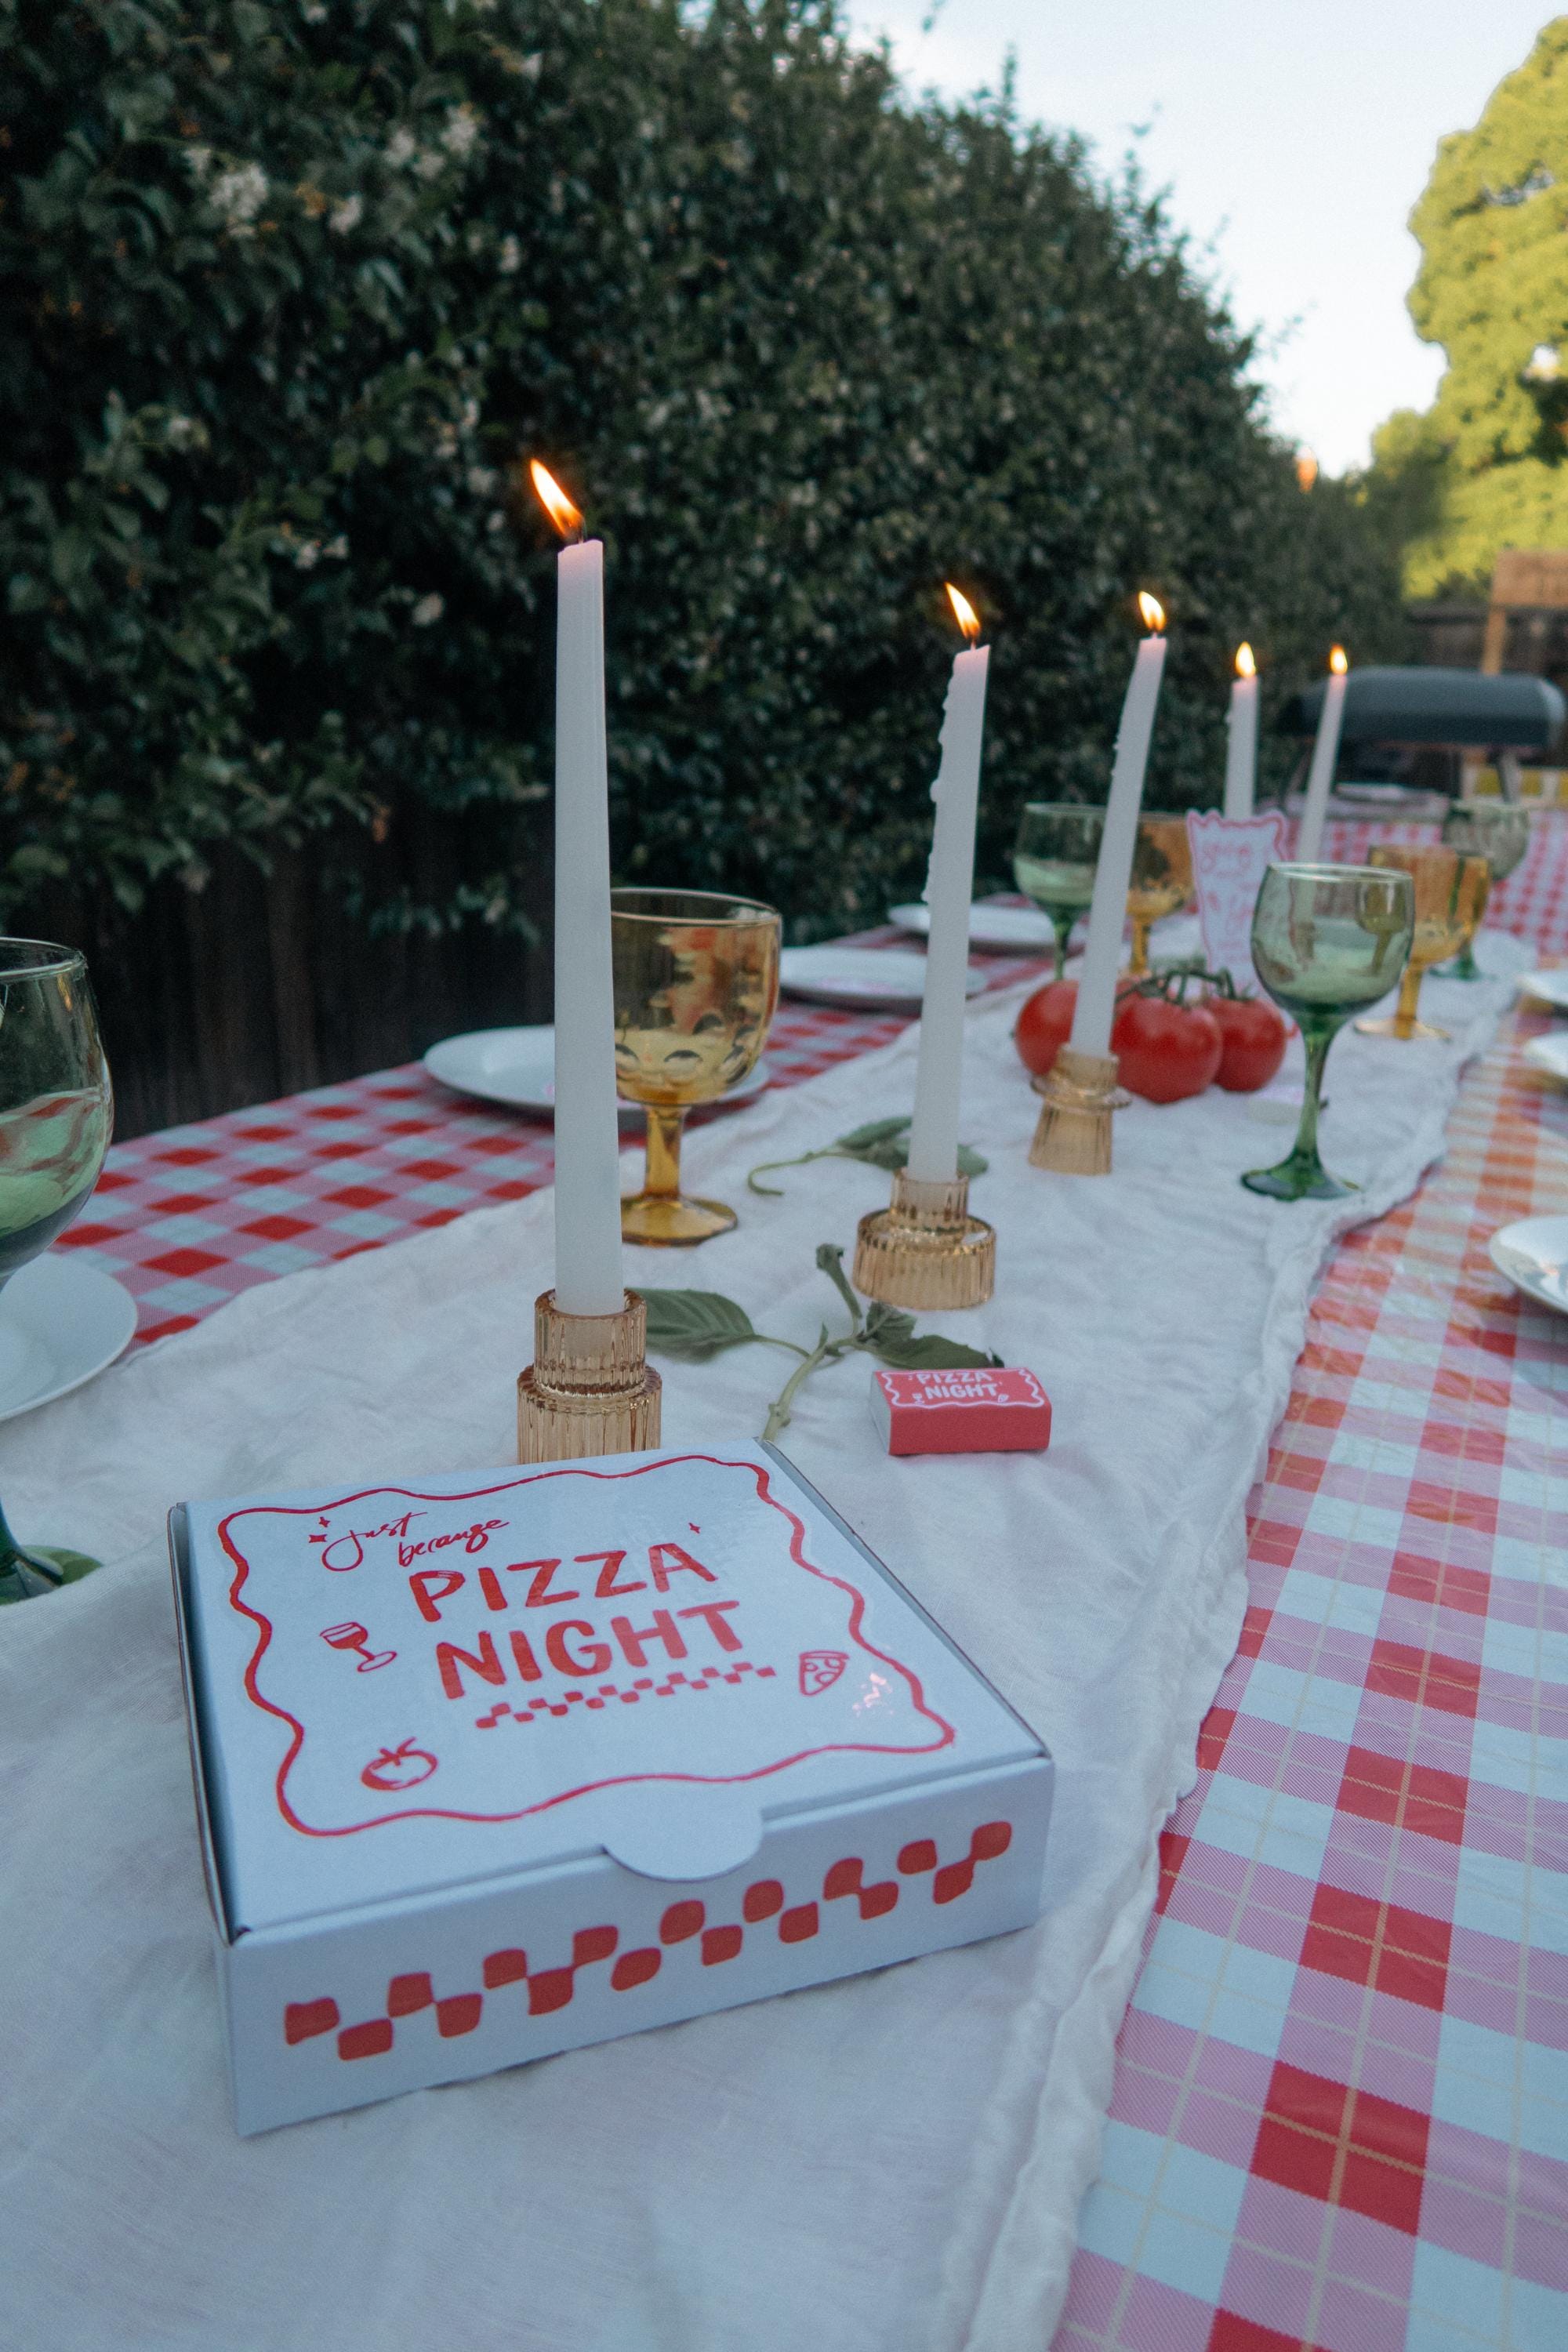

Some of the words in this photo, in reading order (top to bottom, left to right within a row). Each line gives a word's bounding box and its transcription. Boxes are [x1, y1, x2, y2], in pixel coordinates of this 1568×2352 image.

[916, 1370, 992, 1385] PIZZA
[924, 1383, 998, 1399] NIGHT
[408, 1543, 718, 1622] PIZZA
[436, 1600, 742, 1700] NIGHT
